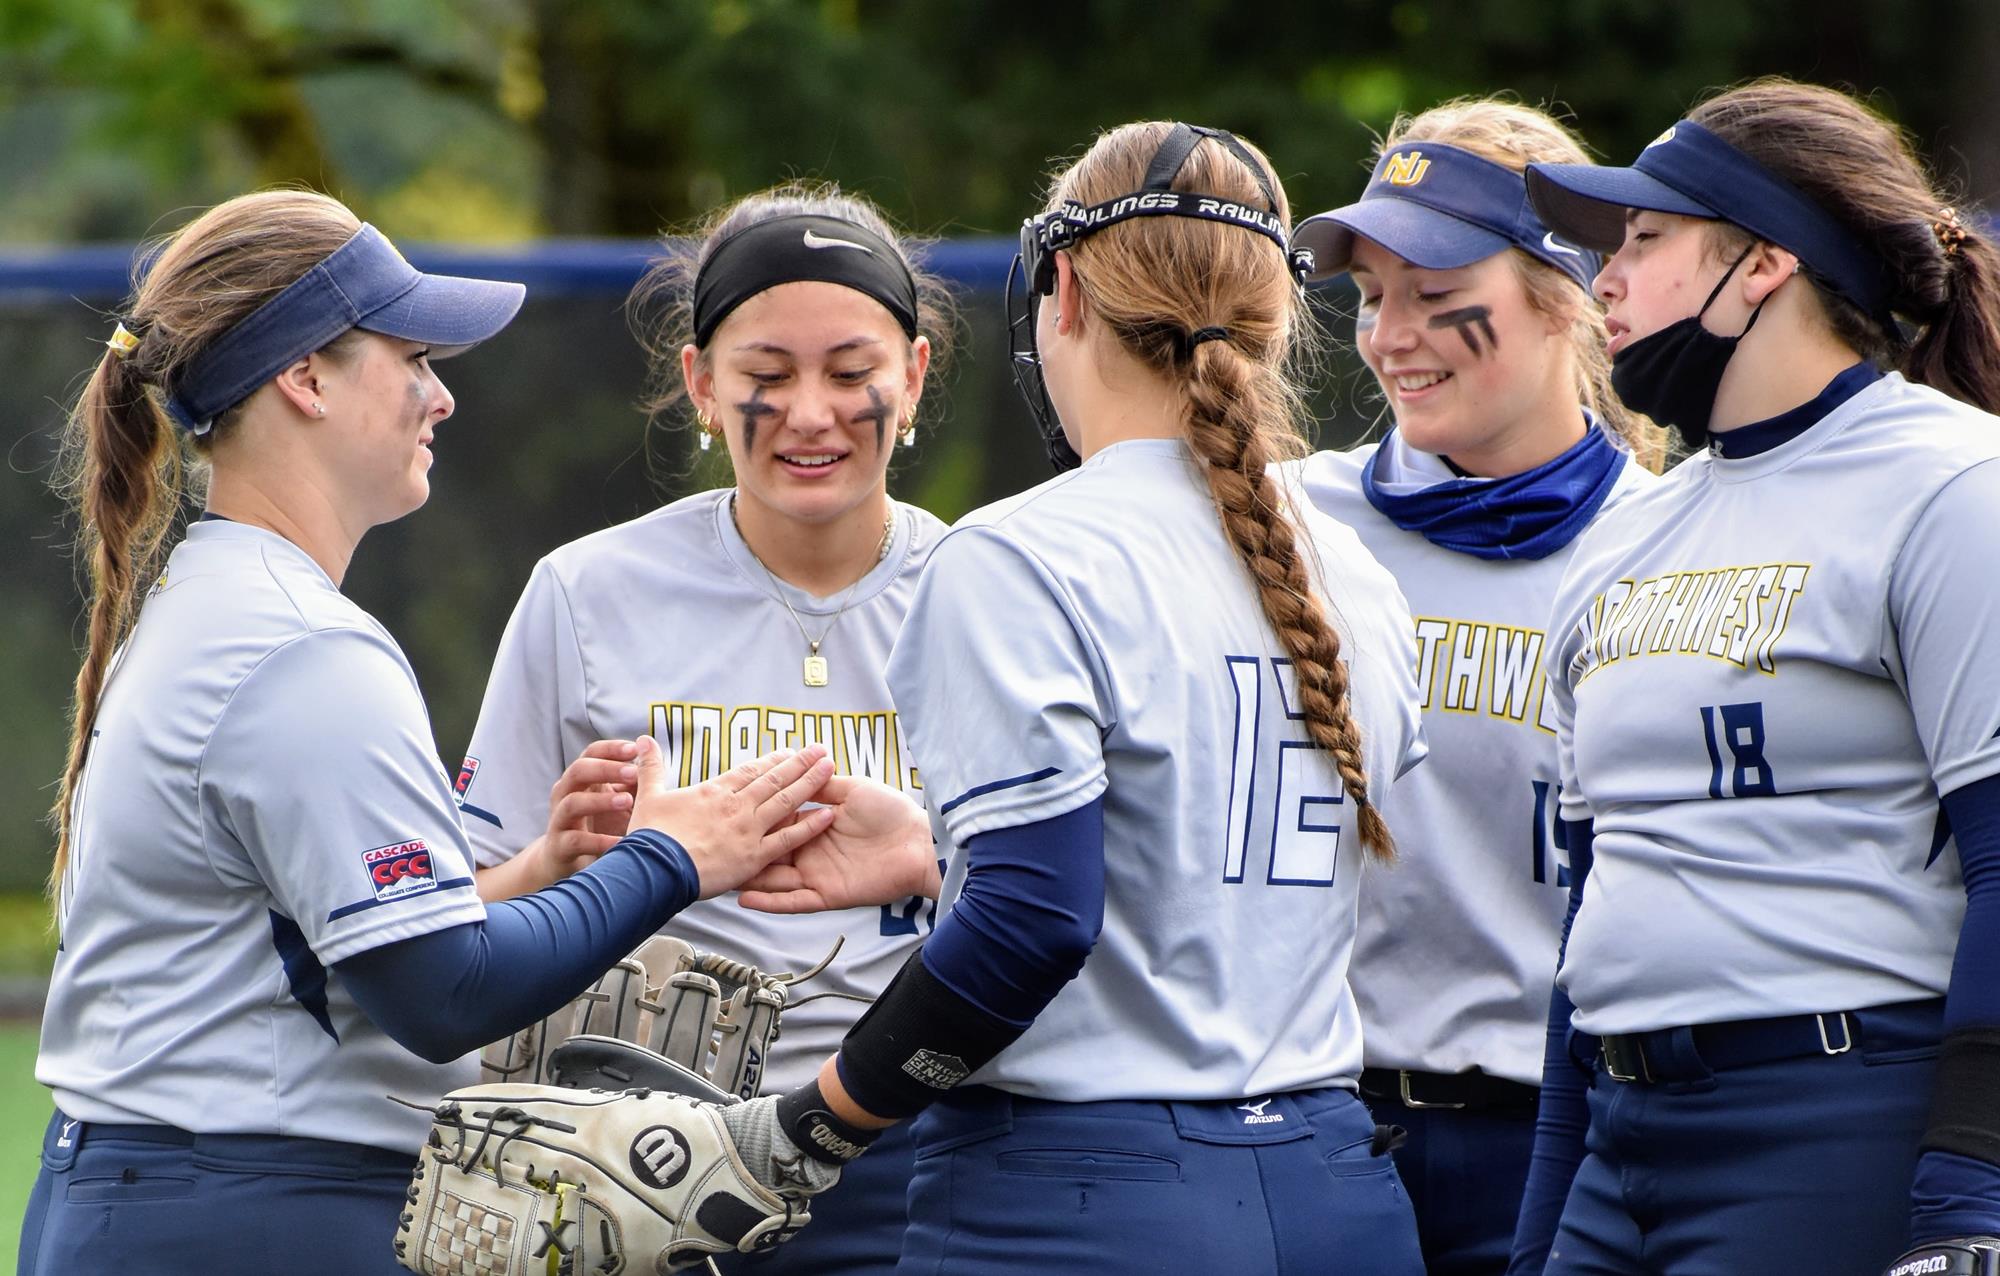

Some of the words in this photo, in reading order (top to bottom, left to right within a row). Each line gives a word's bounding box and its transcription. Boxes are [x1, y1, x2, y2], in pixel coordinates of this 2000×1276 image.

[1380, 151, 1431, 186] NU
[1200, 198, 1286, 248] RAWLIN
[1700, 702, 1777, 799] 18
[364, 840, 427, 862] CASCADE
[371, 854, 431, 885] CCC
[405, 881, 435, 893] CONFERENCE
[1244, 1114, 1284, 1124] MIZUNO
[1889, 1254, 1947, 1276] Wilson
